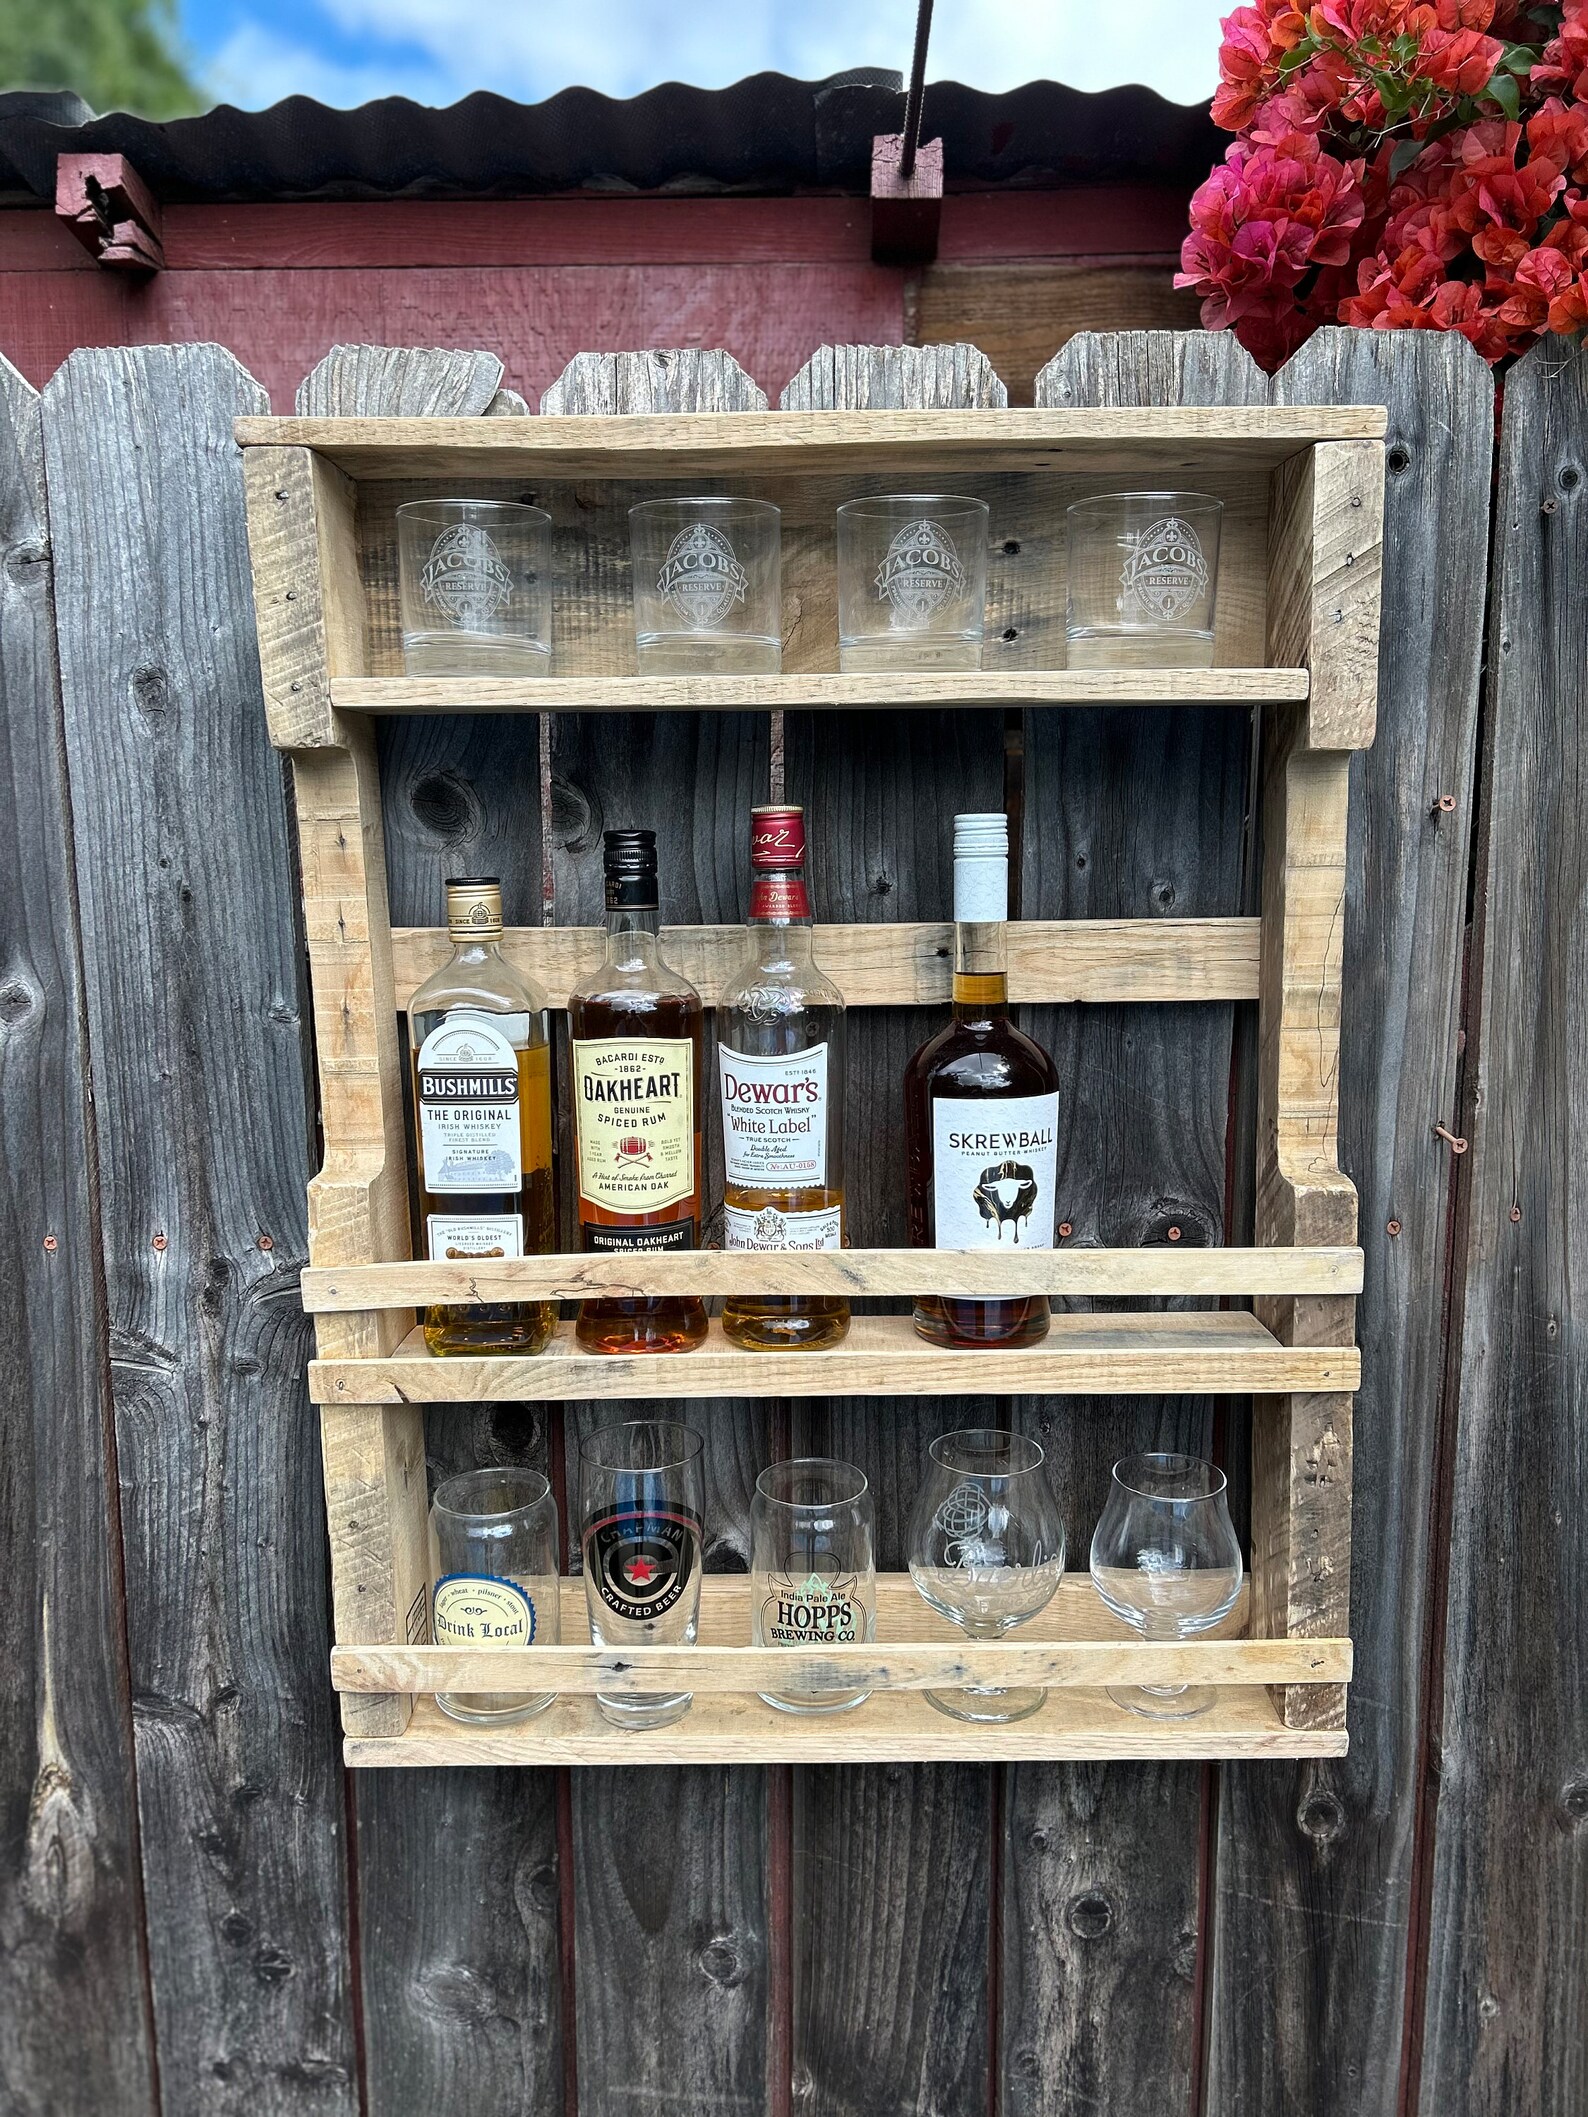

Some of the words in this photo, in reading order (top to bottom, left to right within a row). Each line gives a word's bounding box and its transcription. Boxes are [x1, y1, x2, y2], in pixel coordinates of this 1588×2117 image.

[429, 552, 504, 583] JACOBS
[665, 552, 740, 587] JACOBS
[885, 549, 959, 581] JACOBS
[1131, 547, 1203, 580] JACOBS
[682, 582, 721, 592] RESERVE
[903, 579, 943, 588] RESERVE
[1149, 576, 1189, 585] RESERVE
[595, 1052, 638, 1066] BACARDI
[422, 1076, 517, 1096] BUSHMILLS
[584, 1072, 681, 1102] OAKHEART
[724, 1072, 819, 1104] Dewar's
[427, 1109, 449, 1121] THE
[454, 1109, 512, 1121] ORIGINAL
[613, 1106, 651, 1114] GENUINE
[597, 1113, 638, 1128] SPICED
[642, 1112, 667, 1127] RUM
[949, 1127, 1053, 1149] SKREWBALL
[1023, 1146, 1047, 1154] WHISKEY
[598, 1182, 647, 1191] AMERICAN
[650, 1181, 669, 1190] OAK
[593, 1235, 635, 1247] ORIGINAL
[636, 1231, 684, 1246] OAKHEART
[728, 1233, 746, 1249] John
[746, 1237, 779, 1250] Dewar
[788, 1240, 814, 1250] Sons
[450, 1587, 468, 1597] wheat
[477, 1587, 502, 1600] pilsner
[506, 1600, 520, 1615] stout
[601, 1586, 652, 1616] CRAFTED
[655, 1584, 682, 1612] BEER
[780, 1589, 803, 1602] India
[806, 1593, 828, 1603] Pale
[831, 1592, 846, 1601] Ale
[777, 1600, 852, 1630] HOPPS
[437, 1611, 475, 1637] Drink
[480, 1618, 523, 1638] Local
[770, 1627, 835, 1641] BREWING
